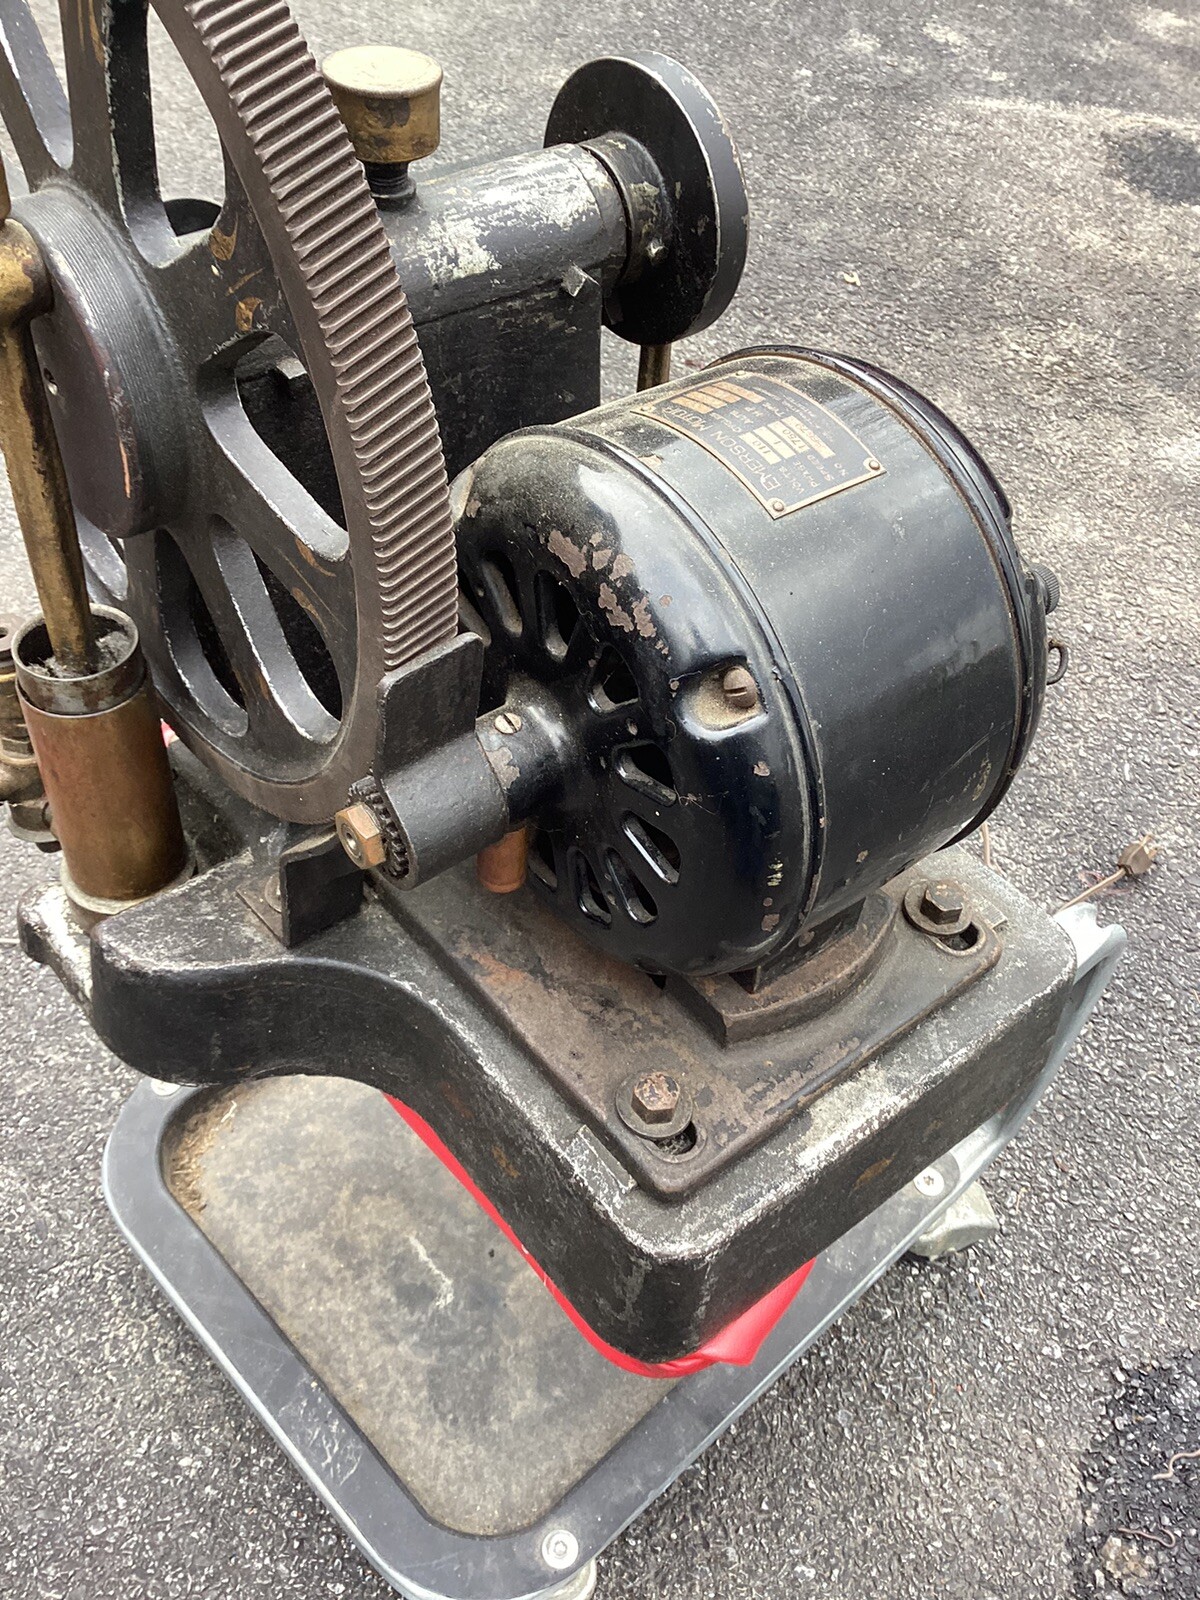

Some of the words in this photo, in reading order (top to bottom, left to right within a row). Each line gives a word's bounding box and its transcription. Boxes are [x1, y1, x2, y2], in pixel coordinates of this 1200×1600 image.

[656, 405, 716, 431] MOTOR
[749, 438, 773, 455] 110
[779, 427, 808, 450] 1750
[705, 429, 782, 491] EMERSON
[791, 458, 821, 488] PHASE
[805, 452, 835, 482] SPEED
[776, 464, 807, 495] VOLTS
